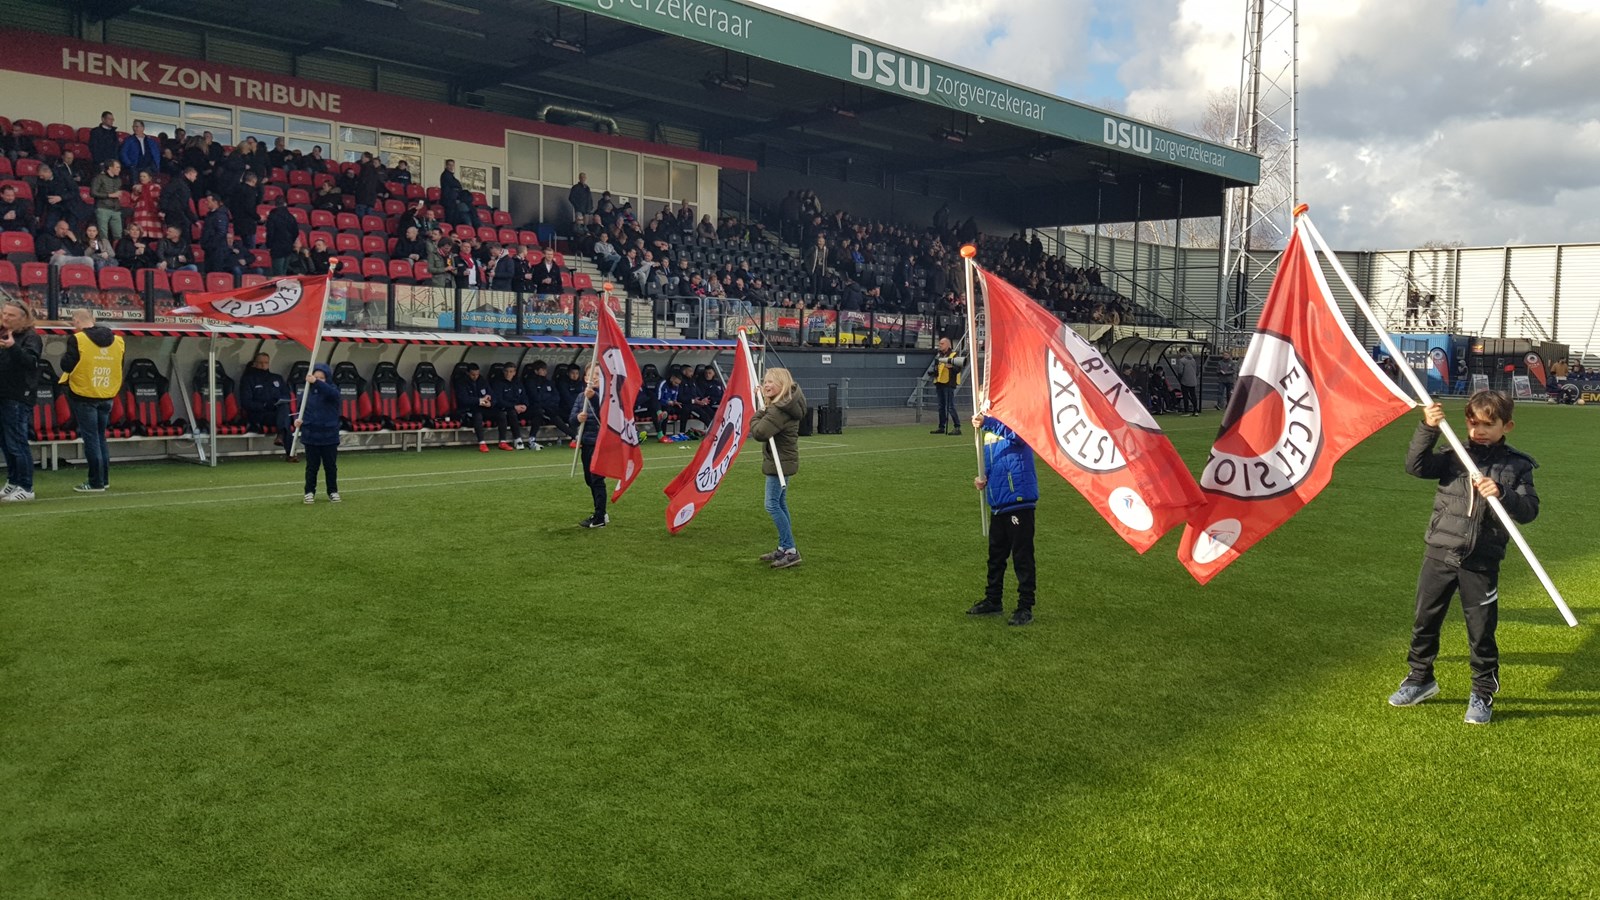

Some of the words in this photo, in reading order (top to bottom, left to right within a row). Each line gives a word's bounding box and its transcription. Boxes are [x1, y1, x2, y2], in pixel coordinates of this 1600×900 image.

[62, 47, 151, 84] HENK
[158, 63, 222, 94] ZON
[229, 75, 342, 115] TRIBUNE
[851, 43, 931, 96] DSW
[936, 74, 1046, 121] zorgverzekeraar
[1103, 117, 1153, 154] DSW
[1155, 137, 1226, 168] zorgverzekeraar
[91, 375, 110, 388] 178
[93, 366, 111, 376] FOTO
[1052, 355, 1118, 465] EXCELSI
